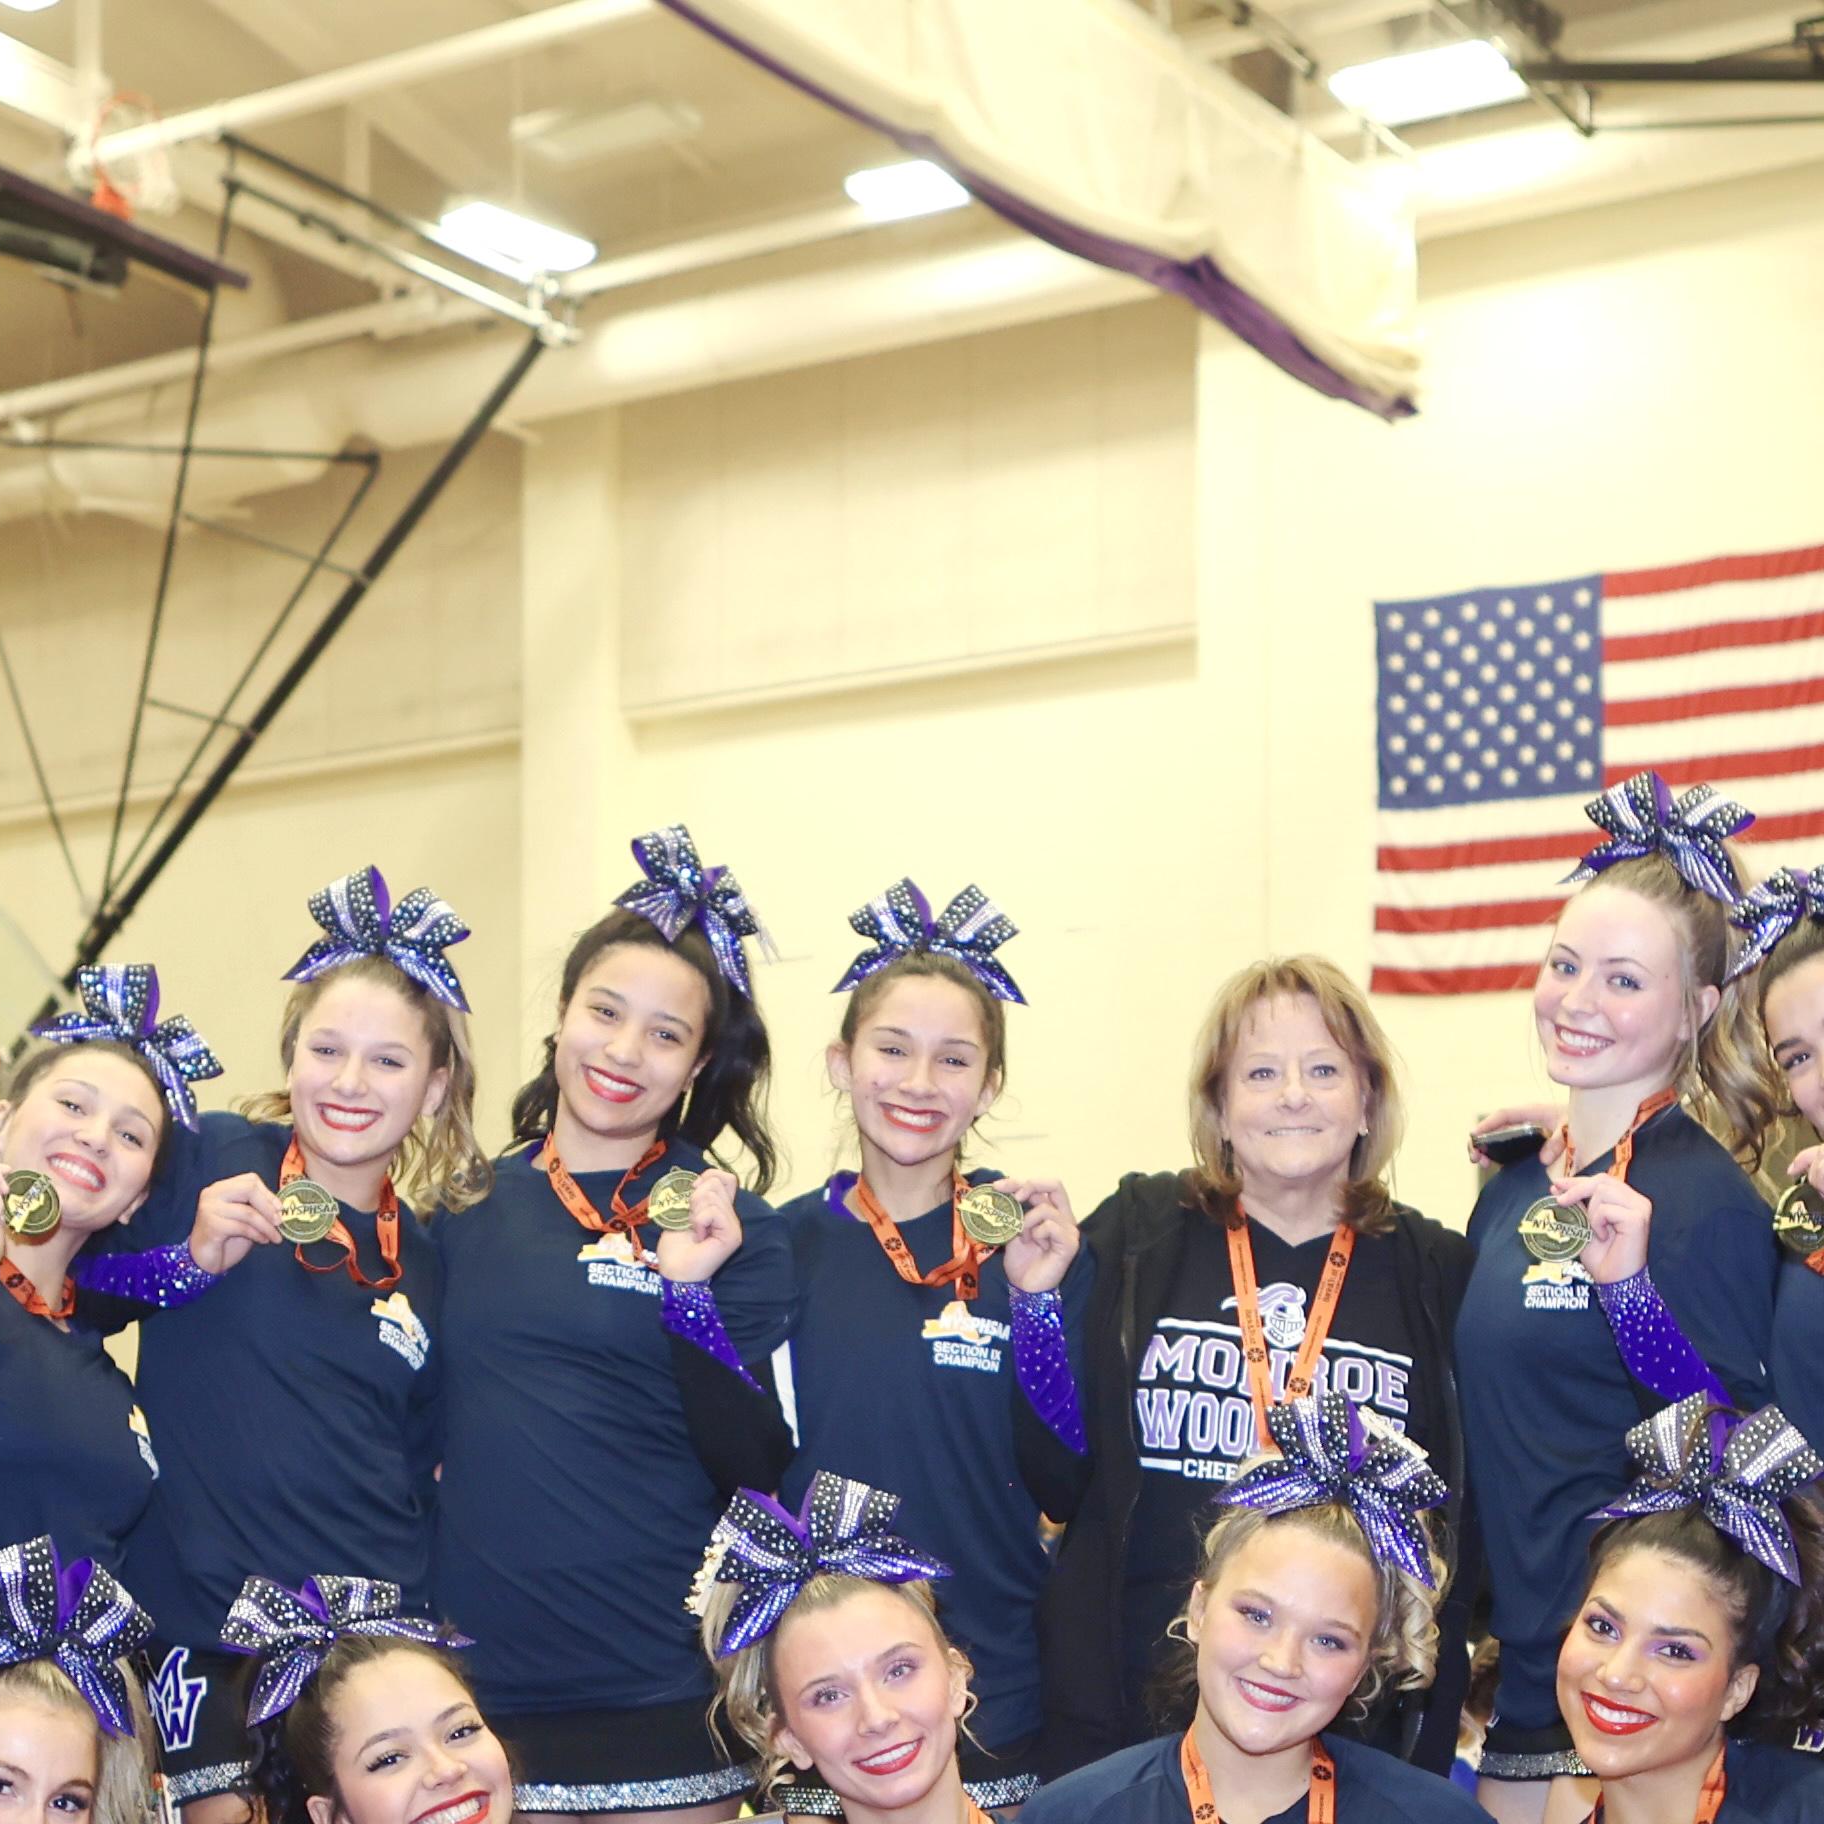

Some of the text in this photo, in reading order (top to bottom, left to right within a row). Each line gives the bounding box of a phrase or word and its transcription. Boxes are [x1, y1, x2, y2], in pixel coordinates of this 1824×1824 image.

[280, 1202, 338, 1217] NYSPHSAA
[588, 1263, 646, 1281] SECTION
[588, 1273, 659, 1295] CHAMPION
[1526, 1285, 1590, 1297] SECTION IX
[1524, 1296, 1589, 1309] CHAMPION
[933, 1341, 1002, 1361] SECTION IX
[933, 1352, 1000, 1373] CHAMPION
